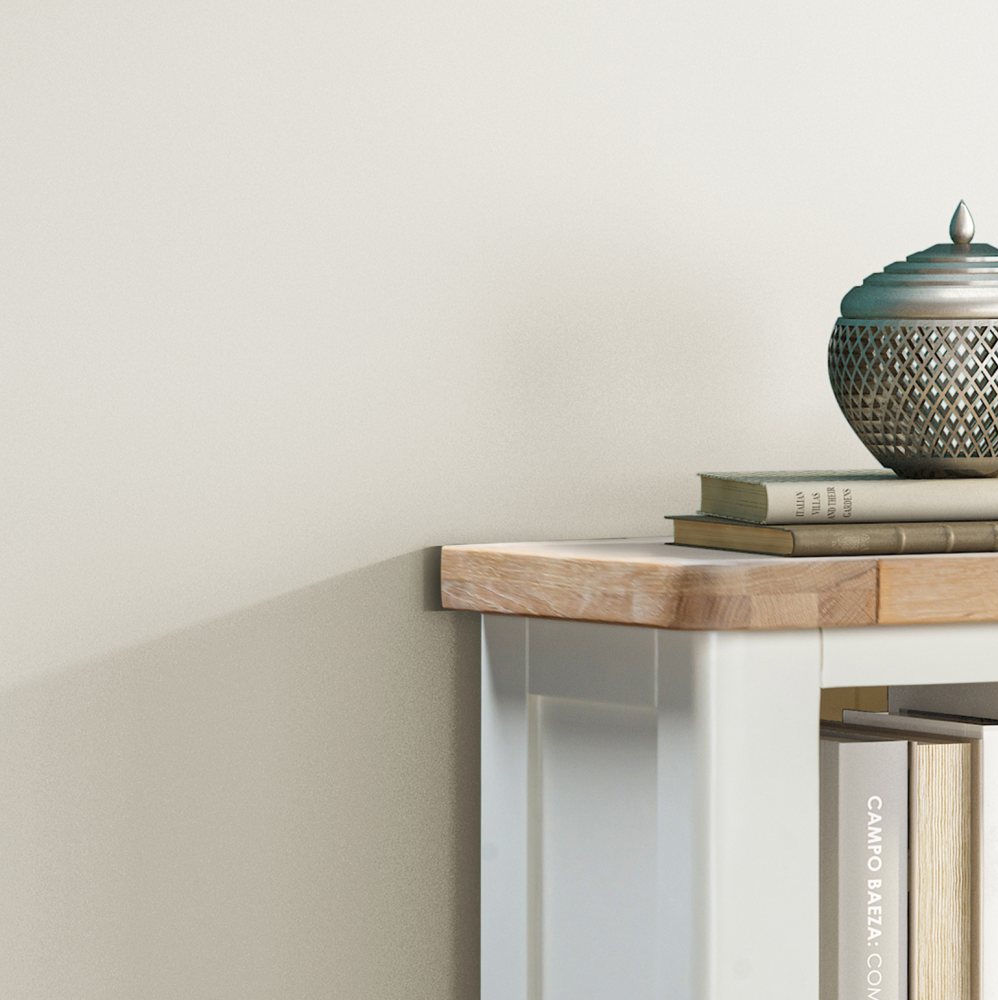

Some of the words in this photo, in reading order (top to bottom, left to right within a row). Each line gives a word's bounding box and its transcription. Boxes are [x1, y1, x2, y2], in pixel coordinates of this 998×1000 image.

[795, 491, 805, 517] ITALIAN
[811, 492, 821, 516] VILLAS
[827, 487, 837, 506] THEIR
[843, 488, 852, 518] GARDENS
[827, 507, 836, 519] AND
[867, 795, 883, 873] CAMPO
[867, 879, 883, 947] BAEZA:
